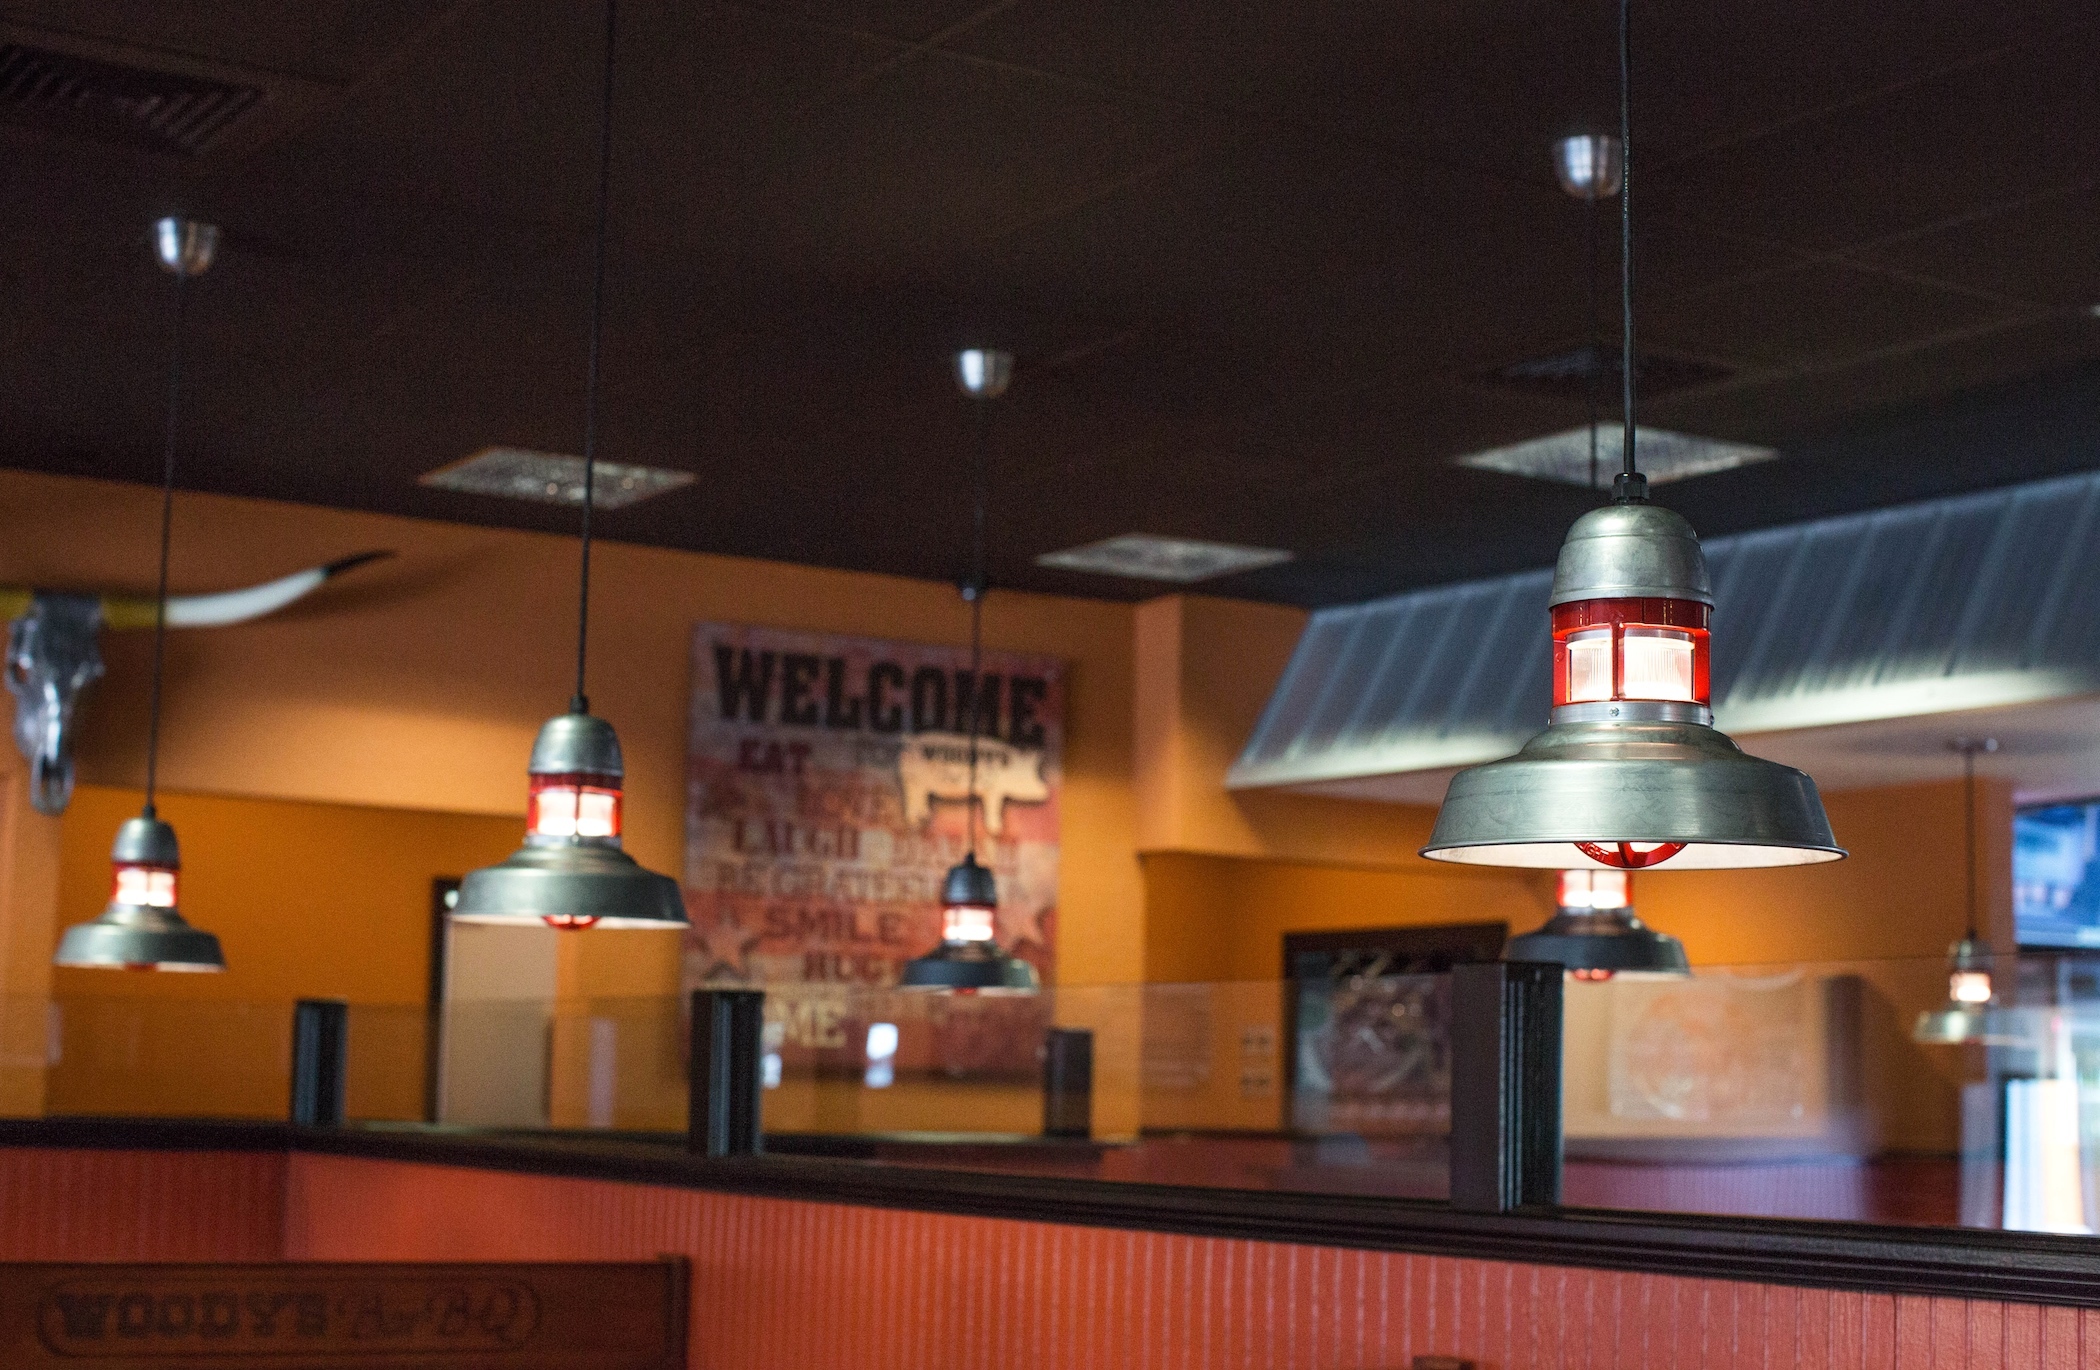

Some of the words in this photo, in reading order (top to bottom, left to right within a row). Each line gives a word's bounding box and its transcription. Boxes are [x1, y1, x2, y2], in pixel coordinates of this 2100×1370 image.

[712, 642, 1048, 750] WELCOME
[739, 738, 812, 775] EAT
[765, 906, 907, 944] SMILE
